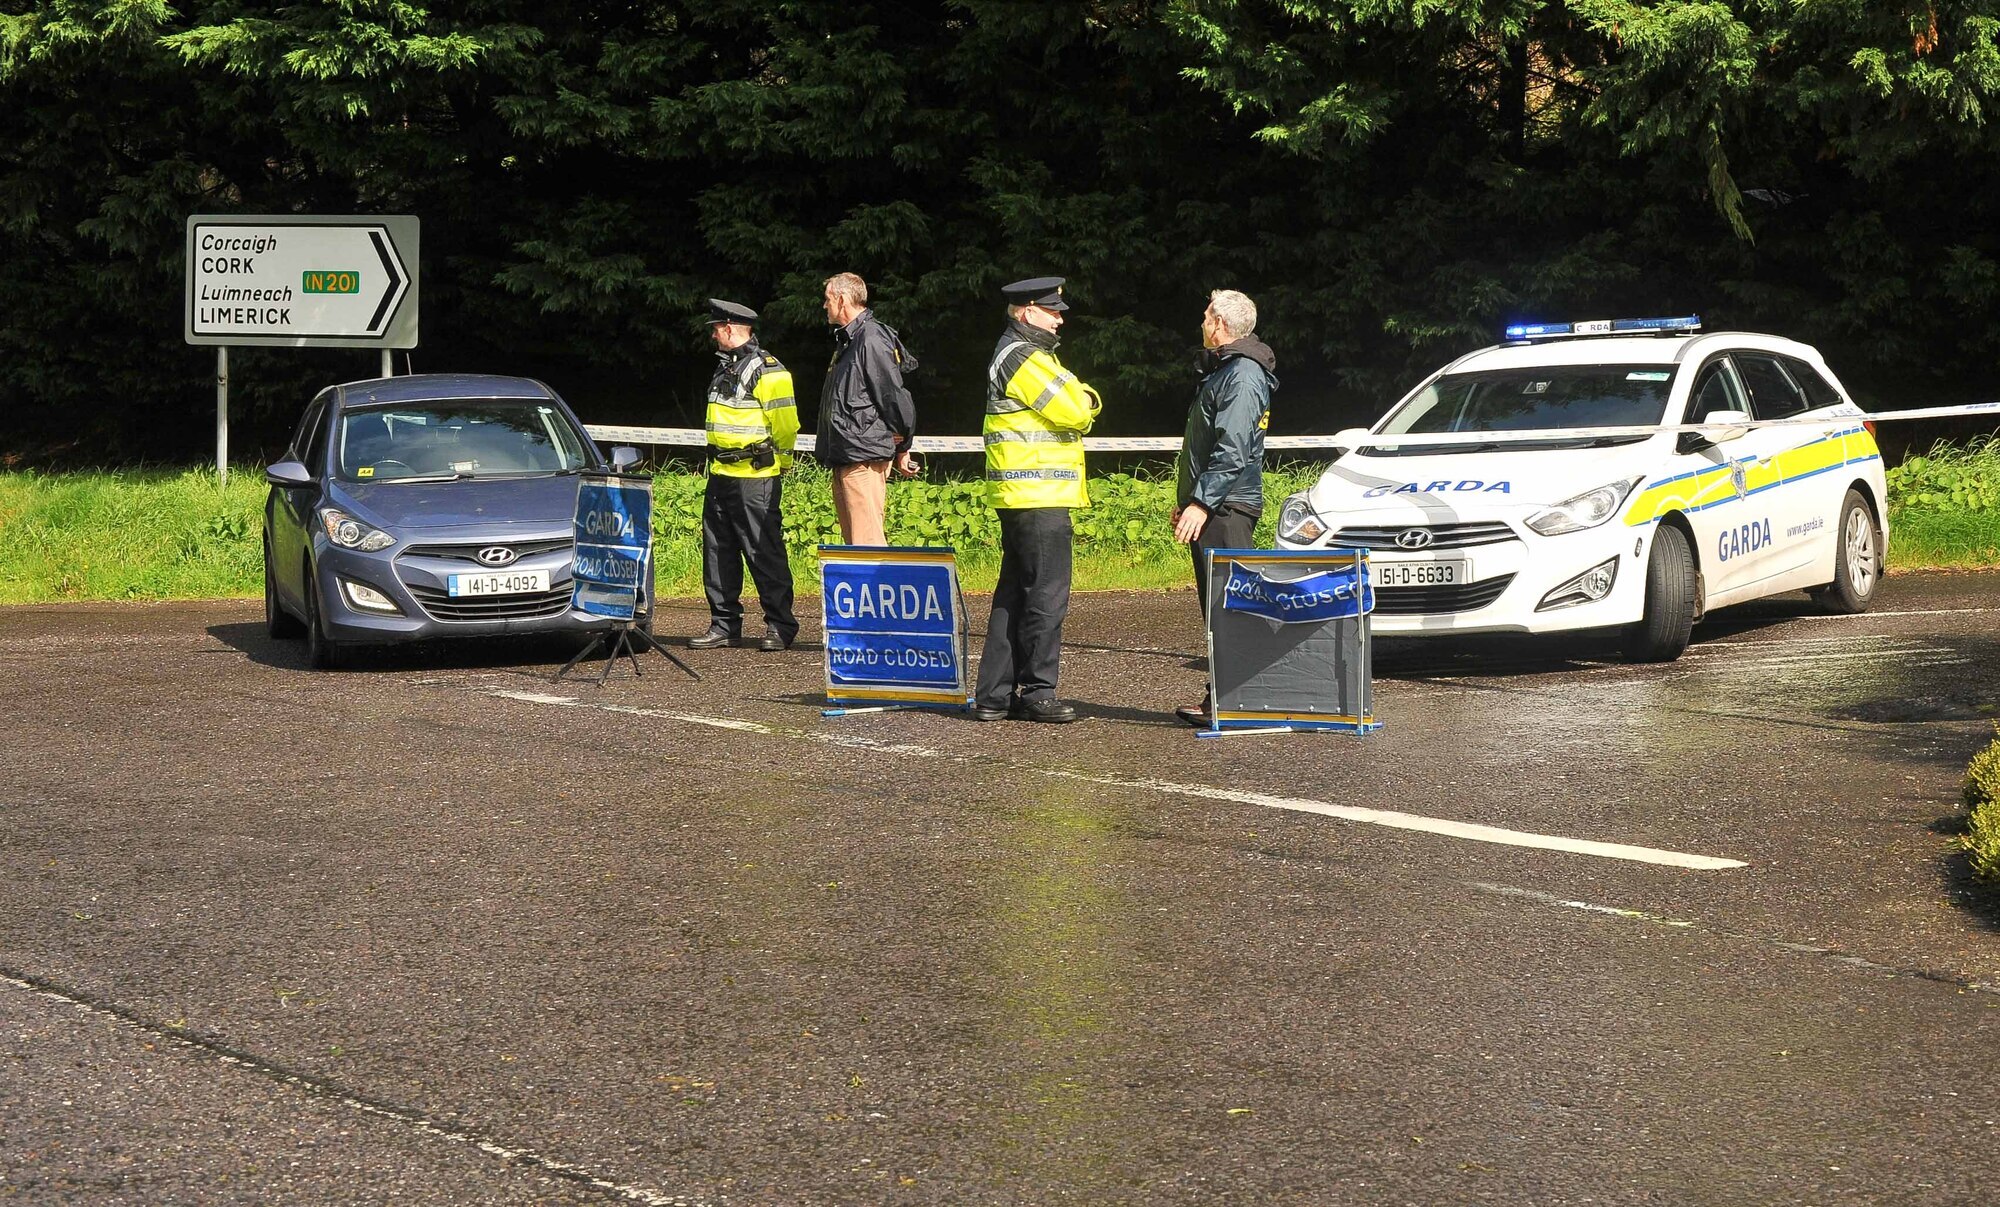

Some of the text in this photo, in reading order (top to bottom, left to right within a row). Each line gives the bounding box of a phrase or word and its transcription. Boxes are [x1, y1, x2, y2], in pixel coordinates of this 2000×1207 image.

[201, 234, 277, 254] Corcaigh
[202, 258, 254, 274] CORK
[305, 273, 356, 292] (N20)
[201, 285, 292, 301] Luimneach
[200, 308, 291, 324] LIMERICK
[1005, 470, 1041, 480] GARDA
[1363, 480, 1511, 498] GARDA
[585, 510, 634, 538] GARDA
[1787, 516, 1824, 538] www.garda.ie
[1719, 517, 1771, 562] GARDA
[573, 555, 637, 579] ROAD CLOSED
[1379, 565, 1454, 585] 151-D-6633
[468, 575, 538, 594] 141-D-4092
[833, 582, 944, 621] GARDA
[831, 647, 951, 668] ROAD CLOSED
